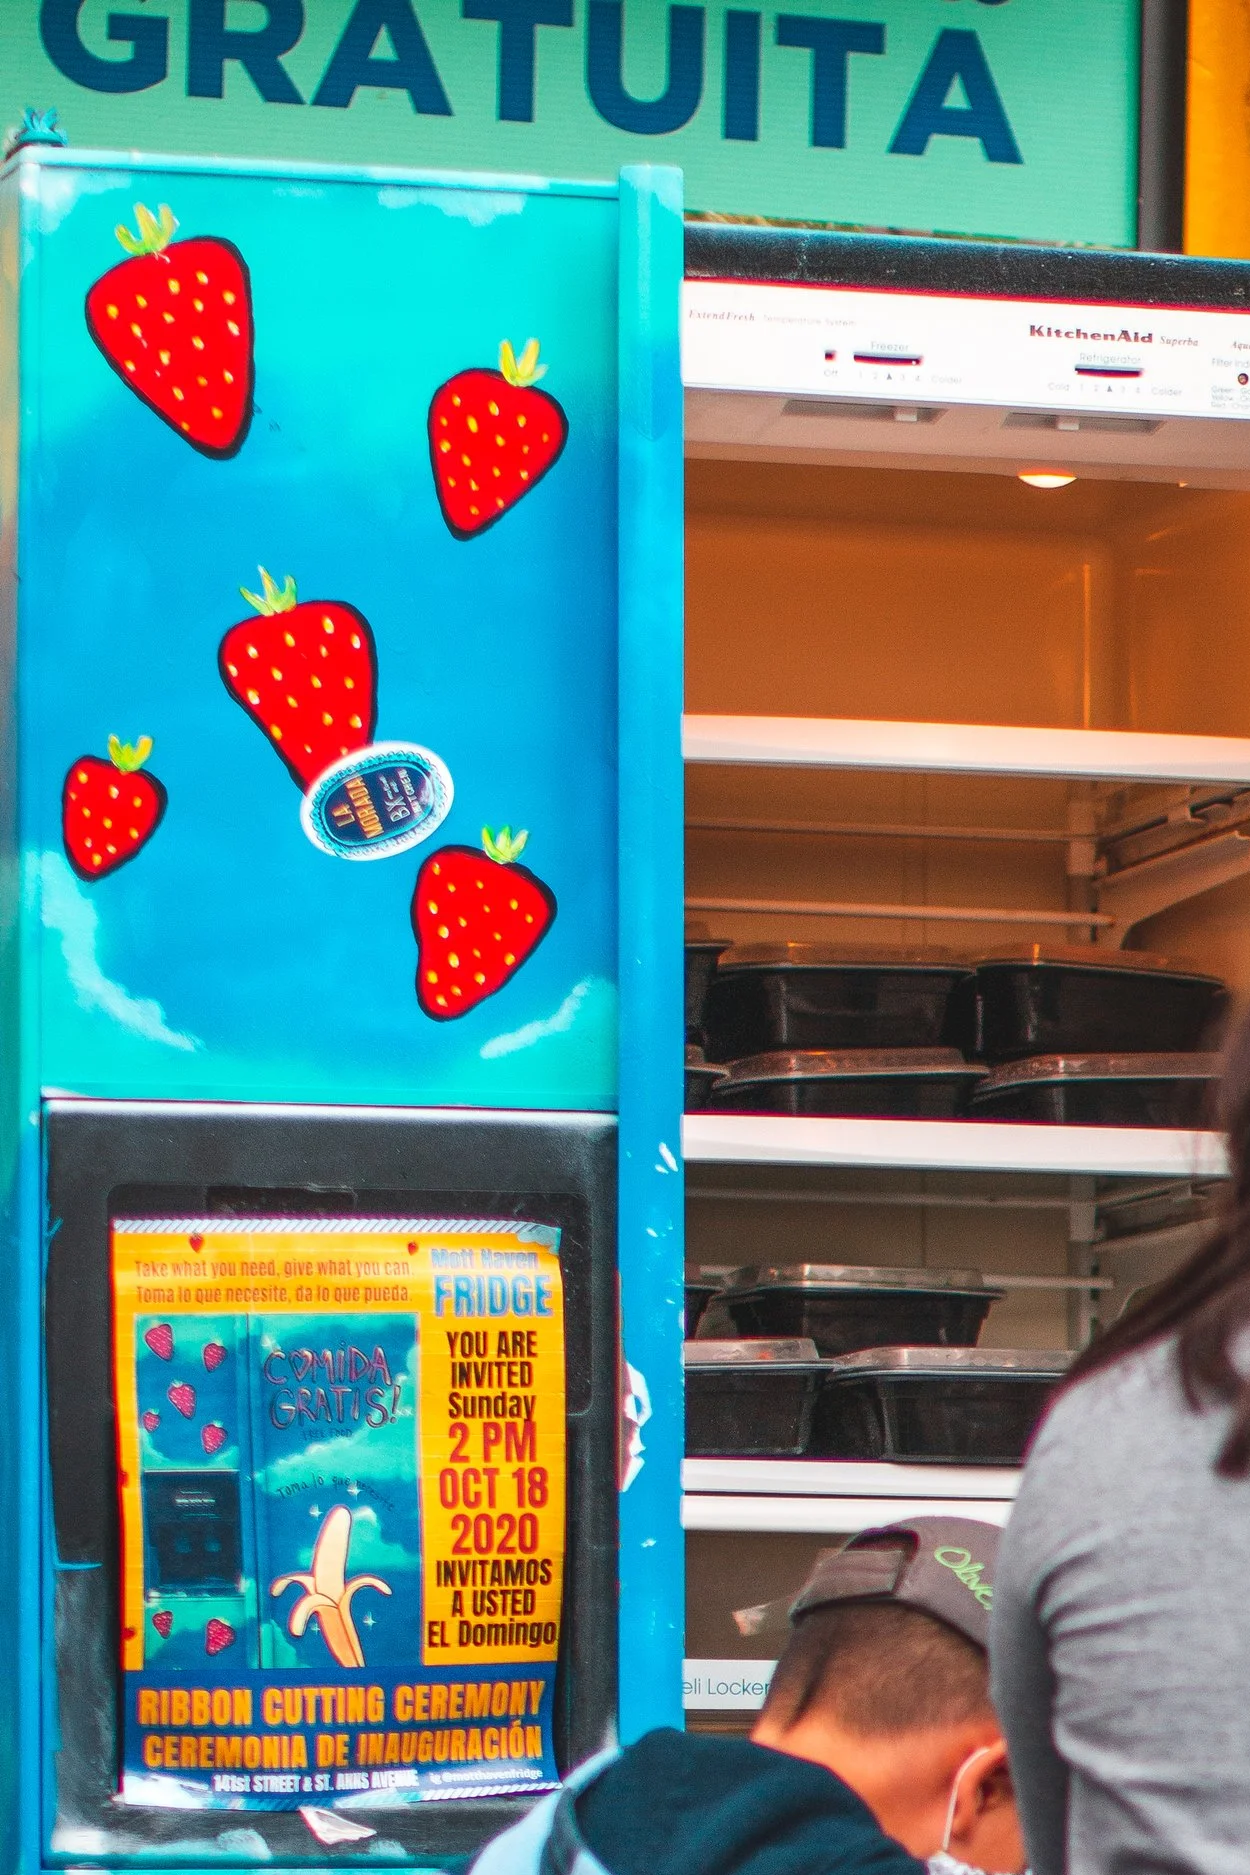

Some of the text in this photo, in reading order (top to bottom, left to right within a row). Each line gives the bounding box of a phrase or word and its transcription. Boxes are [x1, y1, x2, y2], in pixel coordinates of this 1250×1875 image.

[39, 0, 1023, 165] GRATUITA
[871, 340, 909, 352] Freezer
[1029, 324, 1199, 348] KitchenAid Superba
[1079, 352, 1142, 365] Refrigerator
[1212, 358, 1233, 367] Filter
[331, 803, 355, 828] LA
[345, 775, 384, 839] MORADA
[384, 796, 411, 823] BX
[135, 1260, 169, 1278] Take
[172, 1259, 207, 1277] what
[211, 1262, 236, 1280] you
[284, 1258, 313, 1279] give
[317, 1258, 352, 1276] what
[356, 1261, 381, 1279] you
[431, 1248, 539, 1270] Mott Haven
[136, 1286, 175, 1303] Toma
[179, 1286, 192, 1303] lo
[196, 1288, 221, 1306] que
[296, 1284, 313, 1302] da
[317, 1284, 330, 1302] lo
[335, 1287, 360, 1305] que
[364, 1284, 413, 1304] pueda.
[433, 1274, 554, 1318] FRIDGE
[446, 1330, 539, 1359] YOU ARE
[451, 1361, 534, 1389] INVITED
[448, 1392, 537, 1421] Sunday
[449, 1420, 538, 1463] 2 PM
[438, 1466, 549, 1510] OCT 18
[451, 1512, 540, 1556] 2020
[436, 1558, 554, 1588] INVITAMOS
[451, 1588, 537, 1618] A USTED
[428, 1617, 558, 1649] EL Domingo
[683, 1678, 769, 1696] eli Locker
[138, 1680, 546, 1726] RIBBON CUTTING CEREMONY
[143, 1720, 543, 1769] CEREMONIA DE INAUGURACIÓN
[252, 1774, 301, 1793] STREET
[303, 1775, 313, 1792] &
[315, 1774, 334, 1792] ST.
[442, 1768, 543, 1784] @motthavenfridge
